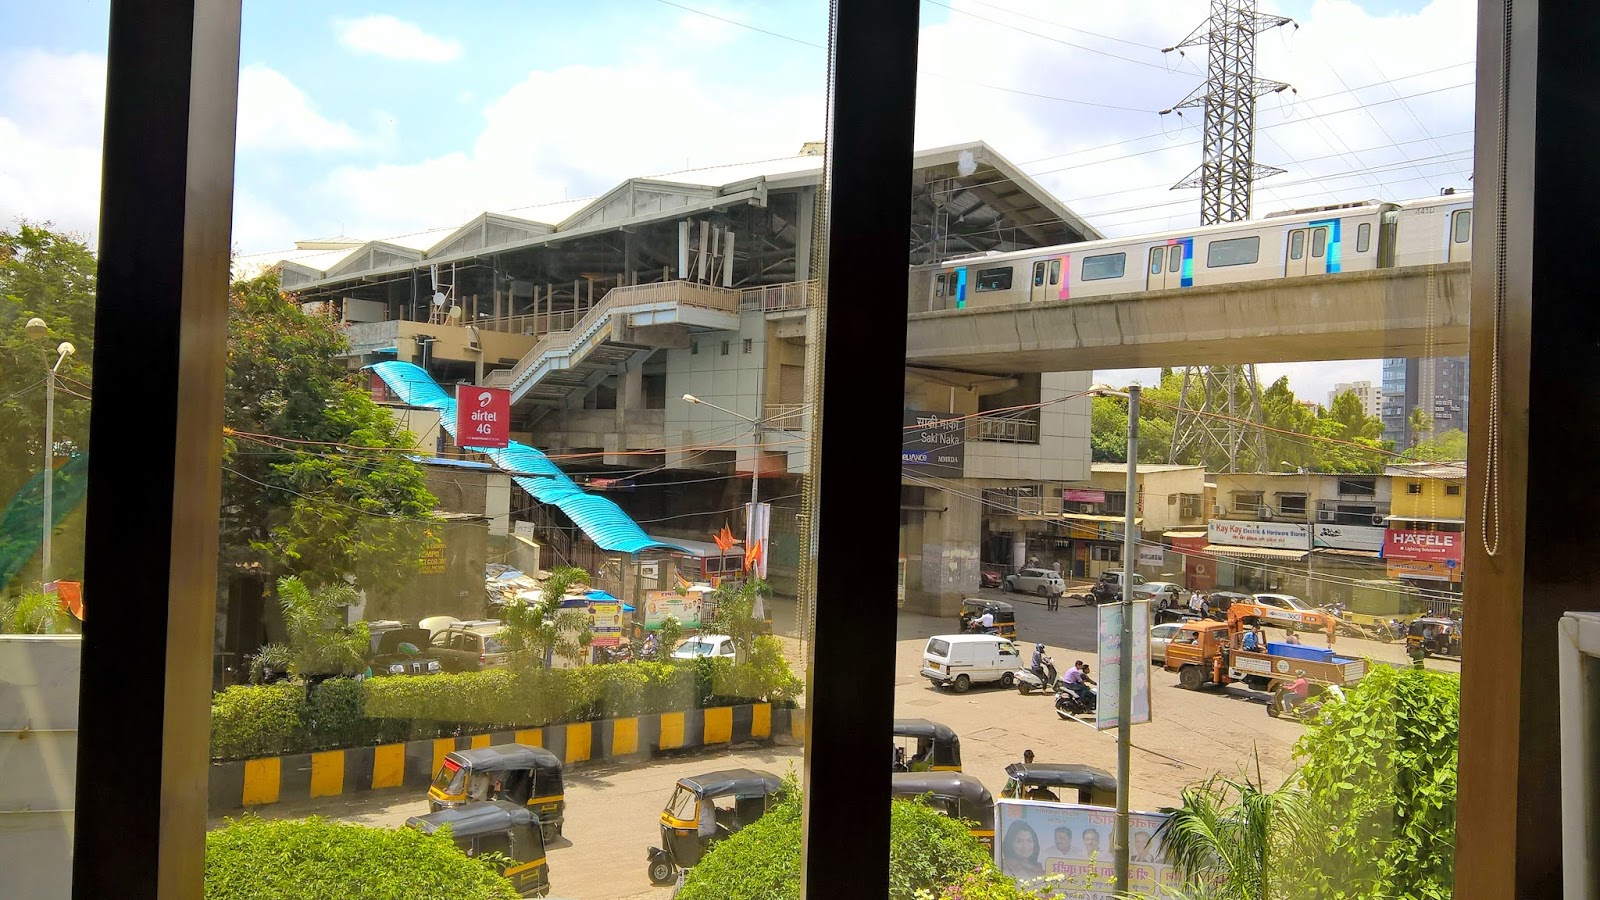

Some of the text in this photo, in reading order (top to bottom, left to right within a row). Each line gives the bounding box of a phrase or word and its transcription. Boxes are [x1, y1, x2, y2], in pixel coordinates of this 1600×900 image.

[471, 410, 497, 422] airtel
[476, 424, 491, 434] 4G
[921, 432, 960, 445] Saki Naka
[1215, 523, 1229, 534] Kay
[1229, 524, 1242, 535] Kay
[1266, 529, 1289, 537] Hardware
